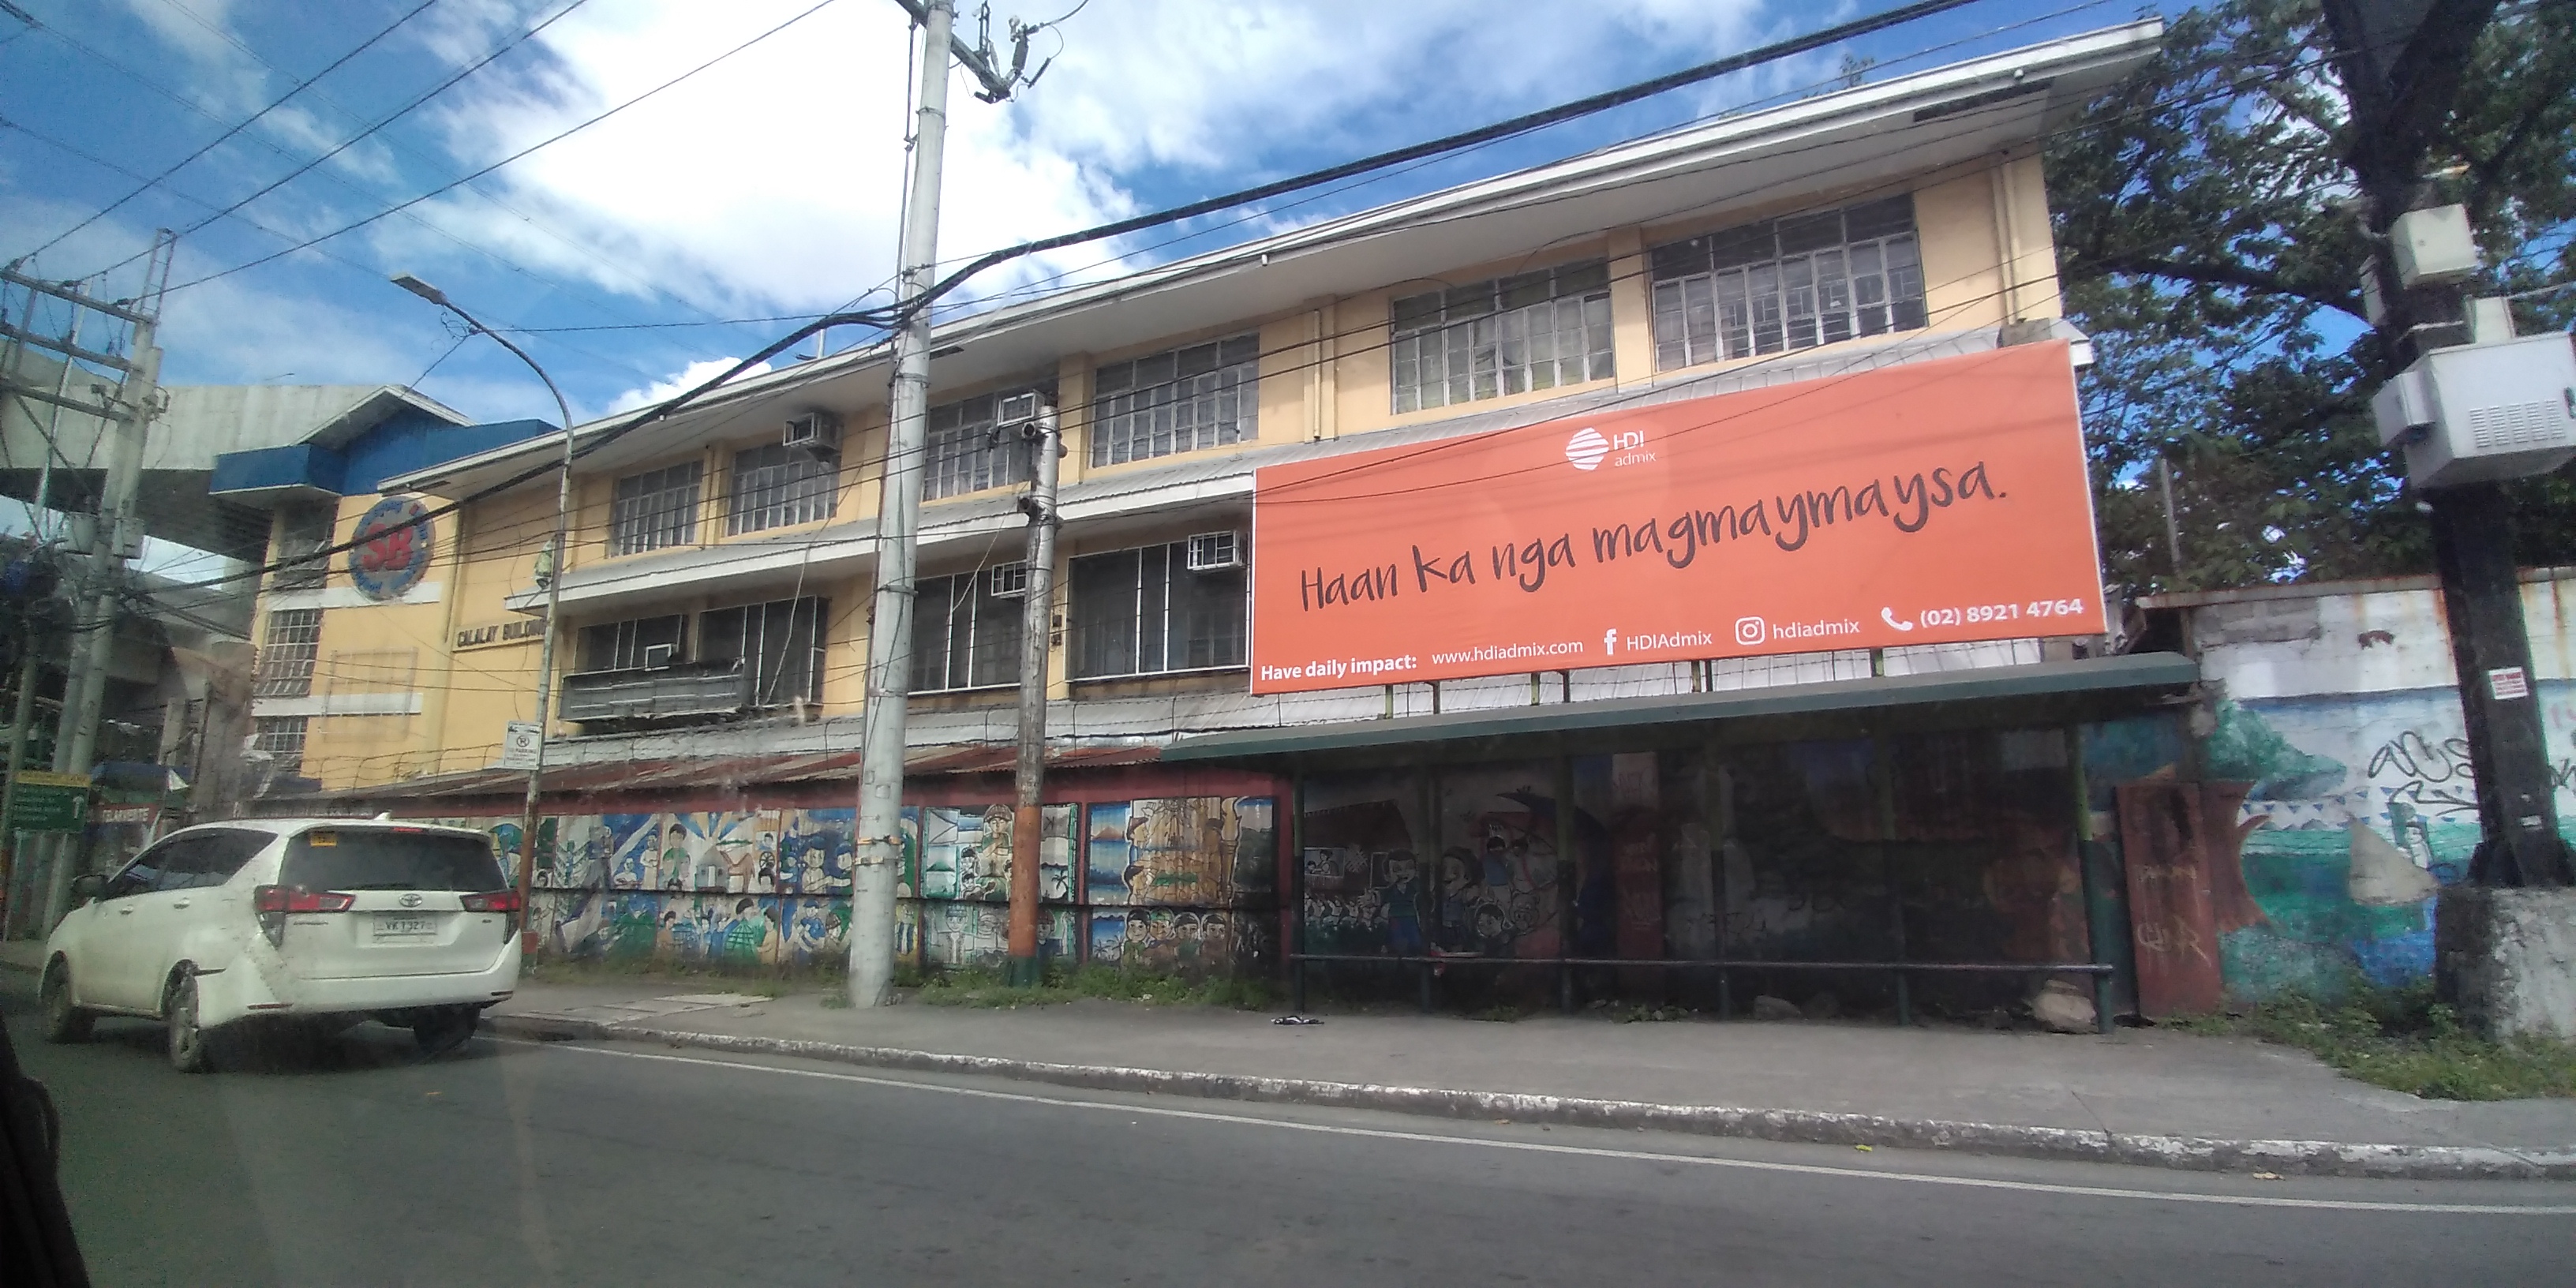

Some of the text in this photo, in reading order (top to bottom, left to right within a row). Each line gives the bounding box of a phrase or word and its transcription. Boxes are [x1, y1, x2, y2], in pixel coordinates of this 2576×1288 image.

[1614, 431, 1644, 450] HDI
[1615, 451, 1657, 466] admix
[1302, 462, 2007, 612] Haan ka nga magmaymaysa.
[1261, 665, 1301, 681] Have
[1305, 660, 1347, 679] daily
[1350, 654, 1417, 676] impact:
[1432, 641, 1583, 665] www.hdiadmix.com
[1627, 631, 1712, 651] HDIAdmix
[1773, 619, 1860, 639] hdiadmix
[1920, 609, 1960, 628] (02)
[1967, 604, 2017, 623] 8921
[2027, 598, 2084, 616] 4764
